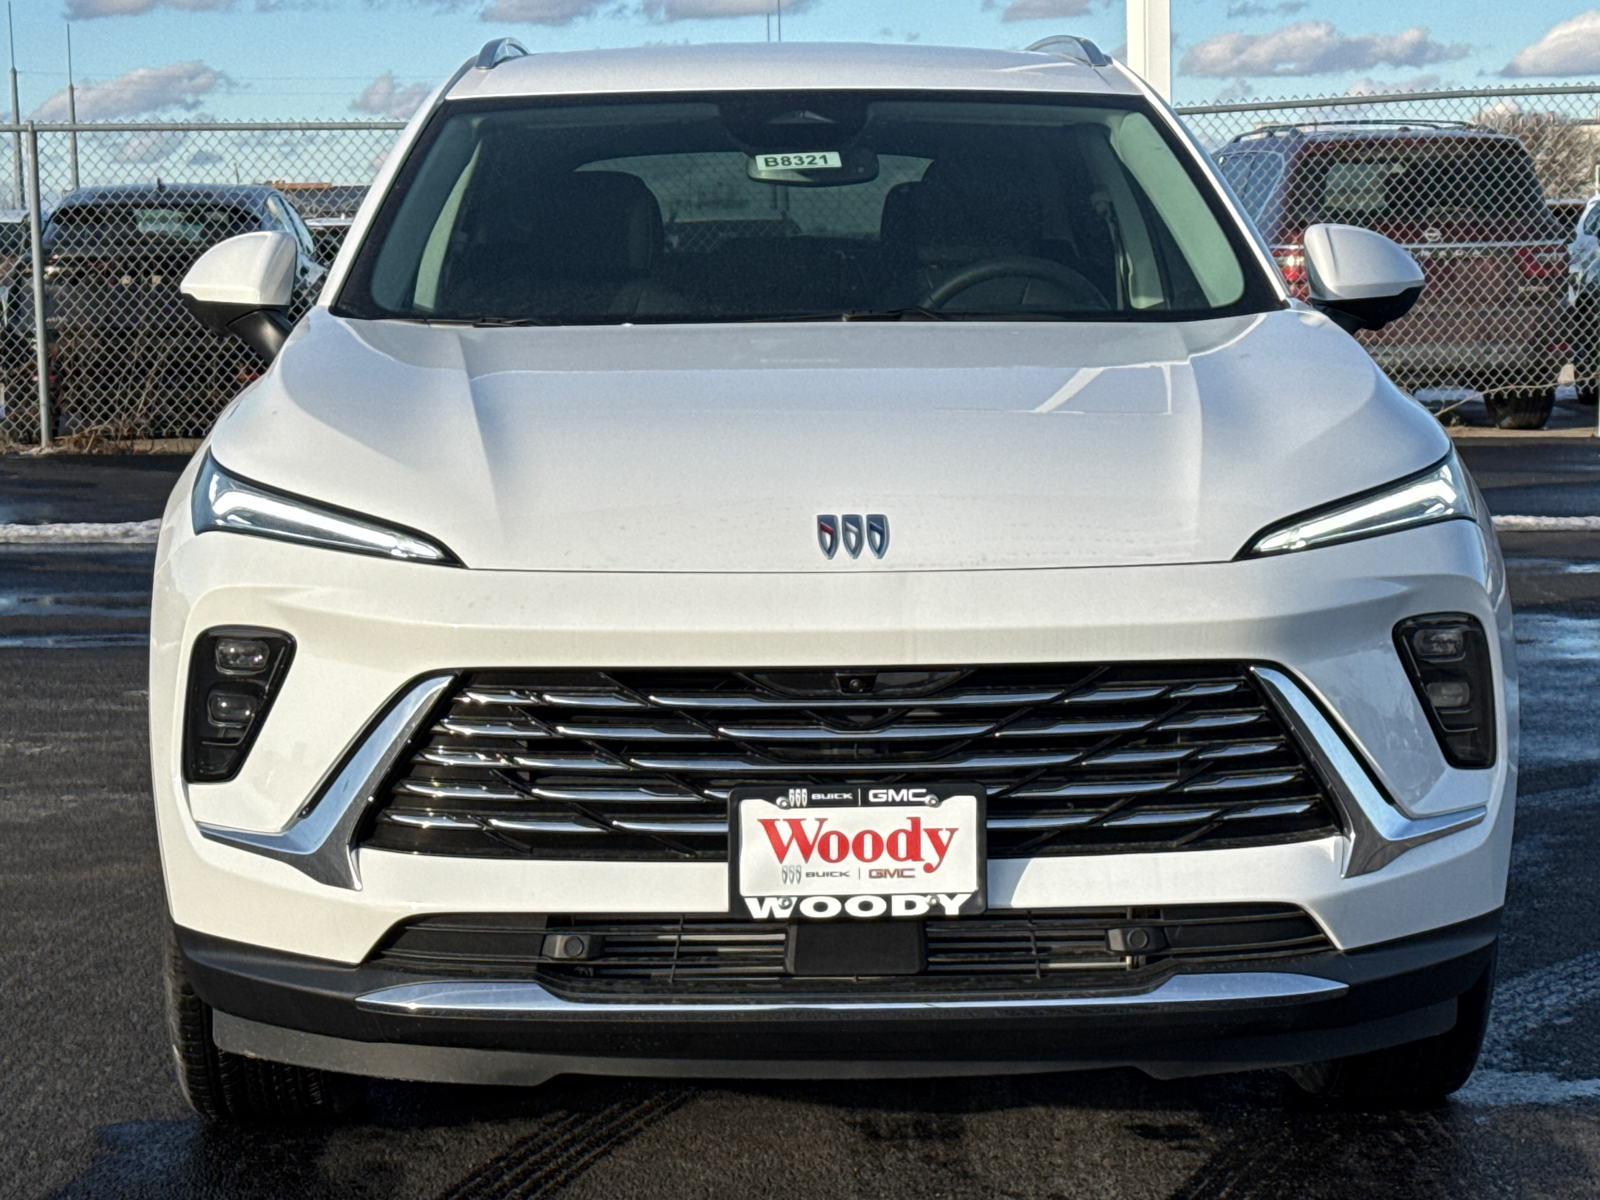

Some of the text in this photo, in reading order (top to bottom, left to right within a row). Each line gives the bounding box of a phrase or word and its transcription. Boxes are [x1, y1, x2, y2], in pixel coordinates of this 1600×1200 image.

[763, 154, 829, 168] B8321
[811, 788, 927, 802] BUICK GMC
[757, 816, 960, 873] Woody
[805, 868, 916, 879] BUICK GMC
[744, 893, 973, 919] WOODY
